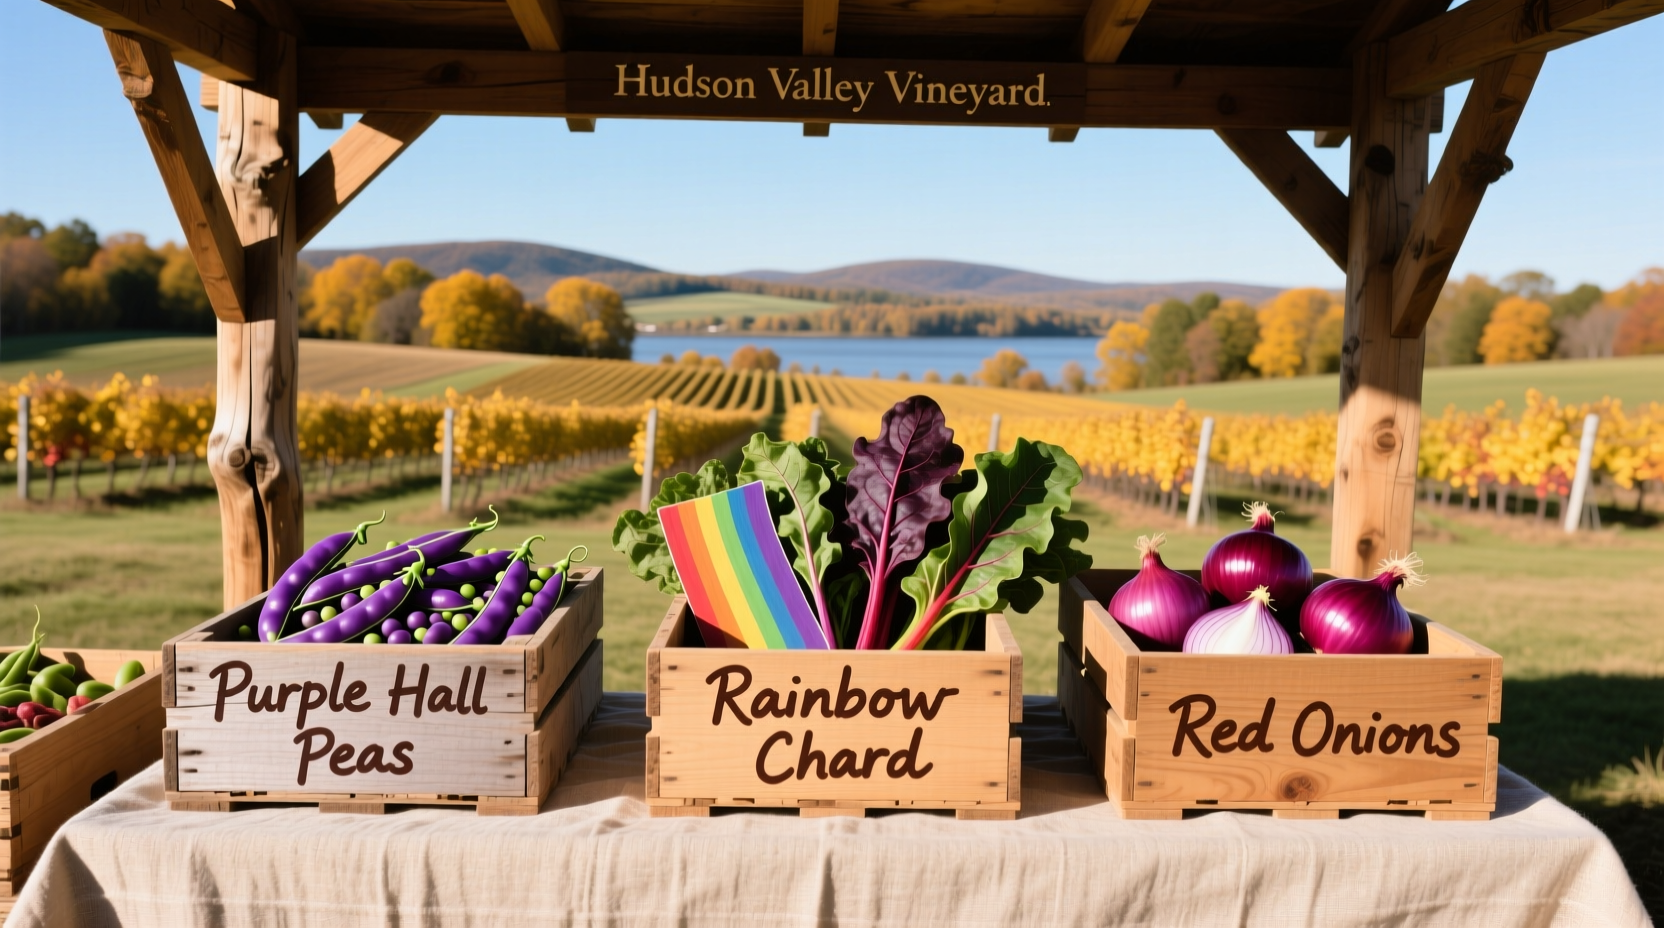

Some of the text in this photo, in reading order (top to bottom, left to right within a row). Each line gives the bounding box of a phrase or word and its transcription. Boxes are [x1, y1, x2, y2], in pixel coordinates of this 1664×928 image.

[613, 63, 1051, 115] Hudson Valley Vineyard.
[209, 660, 488, 730] Purple Hall
[705, 664, 960, 727] Rainbow
[293, 726, 415, 786] Peas
[755, 726, 933, 785] Chard
[1168, 693, 1461, 759] Red Onions
